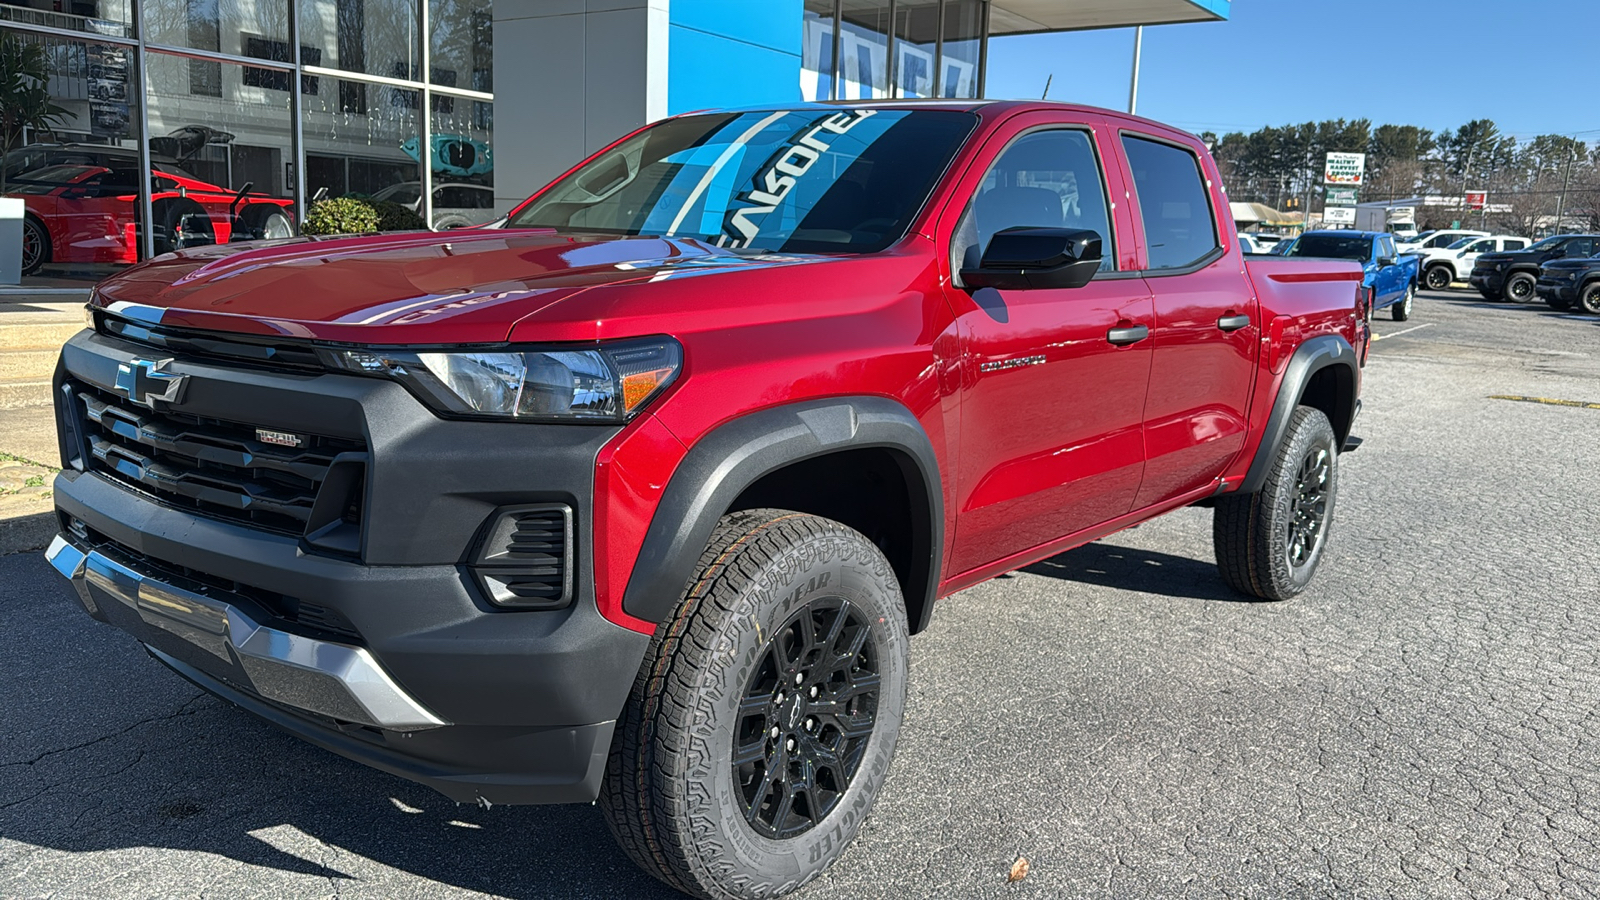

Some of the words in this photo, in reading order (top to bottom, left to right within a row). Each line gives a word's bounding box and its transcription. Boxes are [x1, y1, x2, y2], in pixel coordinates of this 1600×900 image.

[981, 355, 1046, 372] COLORADO
[256, 429, 302, 443] TRAIL
[808, 731, 894, 864] WRANGLER
